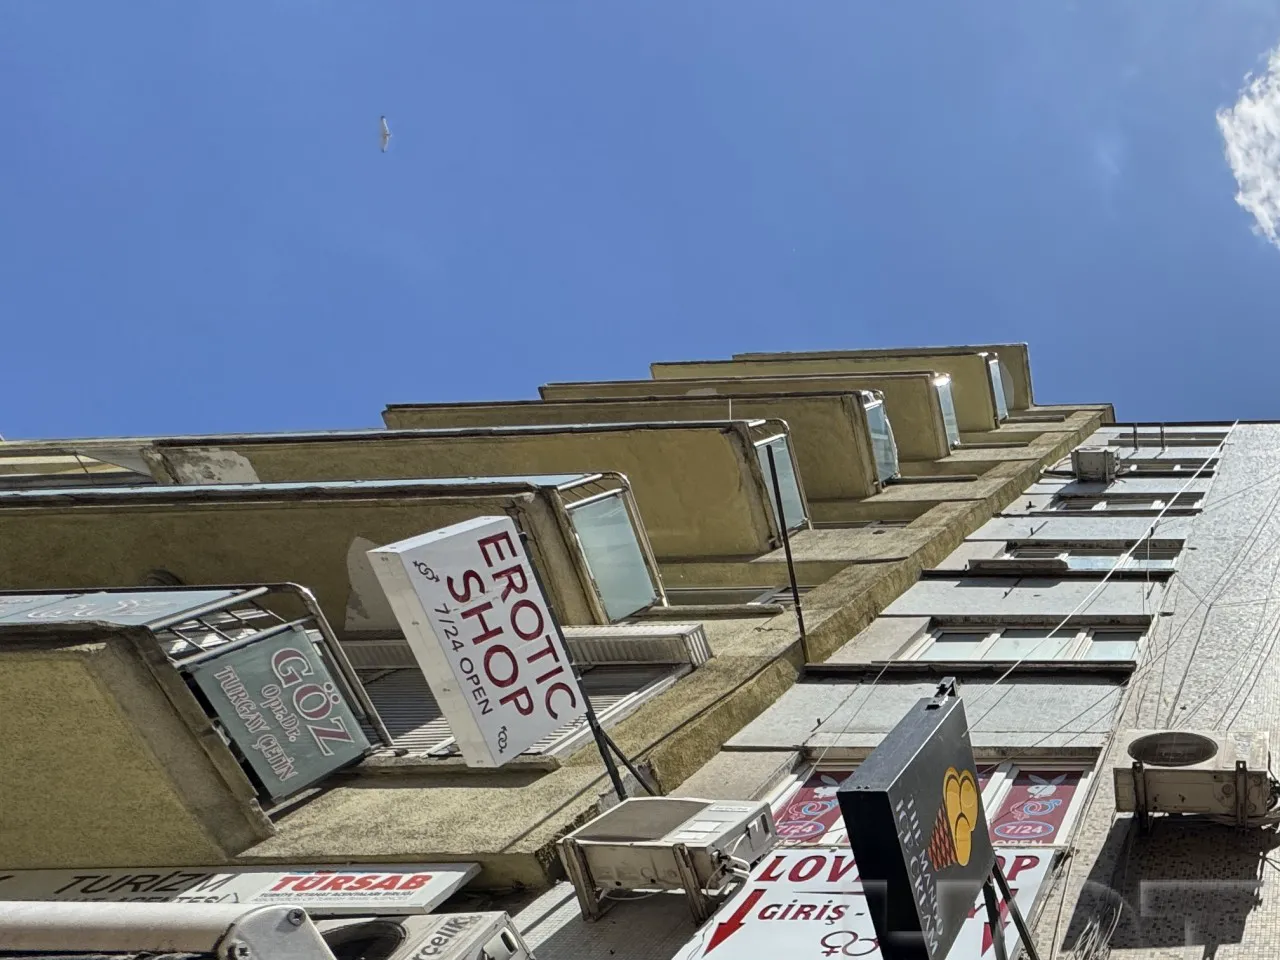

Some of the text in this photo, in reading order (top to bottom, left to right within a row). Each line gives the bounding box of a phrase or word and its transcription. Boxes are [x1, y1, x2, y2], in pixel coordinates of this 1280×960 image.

[446, 569, 534, 716] SHOP
[477, 530, 577, 720] EROTIC
[434, 603, 493, 716] 7/24 OPEN
[213, 665, 299, 782] TURGAY ÇETİN
[271, 648, 355, 757] GÖZ
[1005, 825, 1043, 834] 7/24
[53, 870, 243, 895] TURİZM
[269, 872, 433, 892] TÜRSAB
[754, 855, 862, 882] LOV
[757, 900, 849, 925] GİRİŞ
